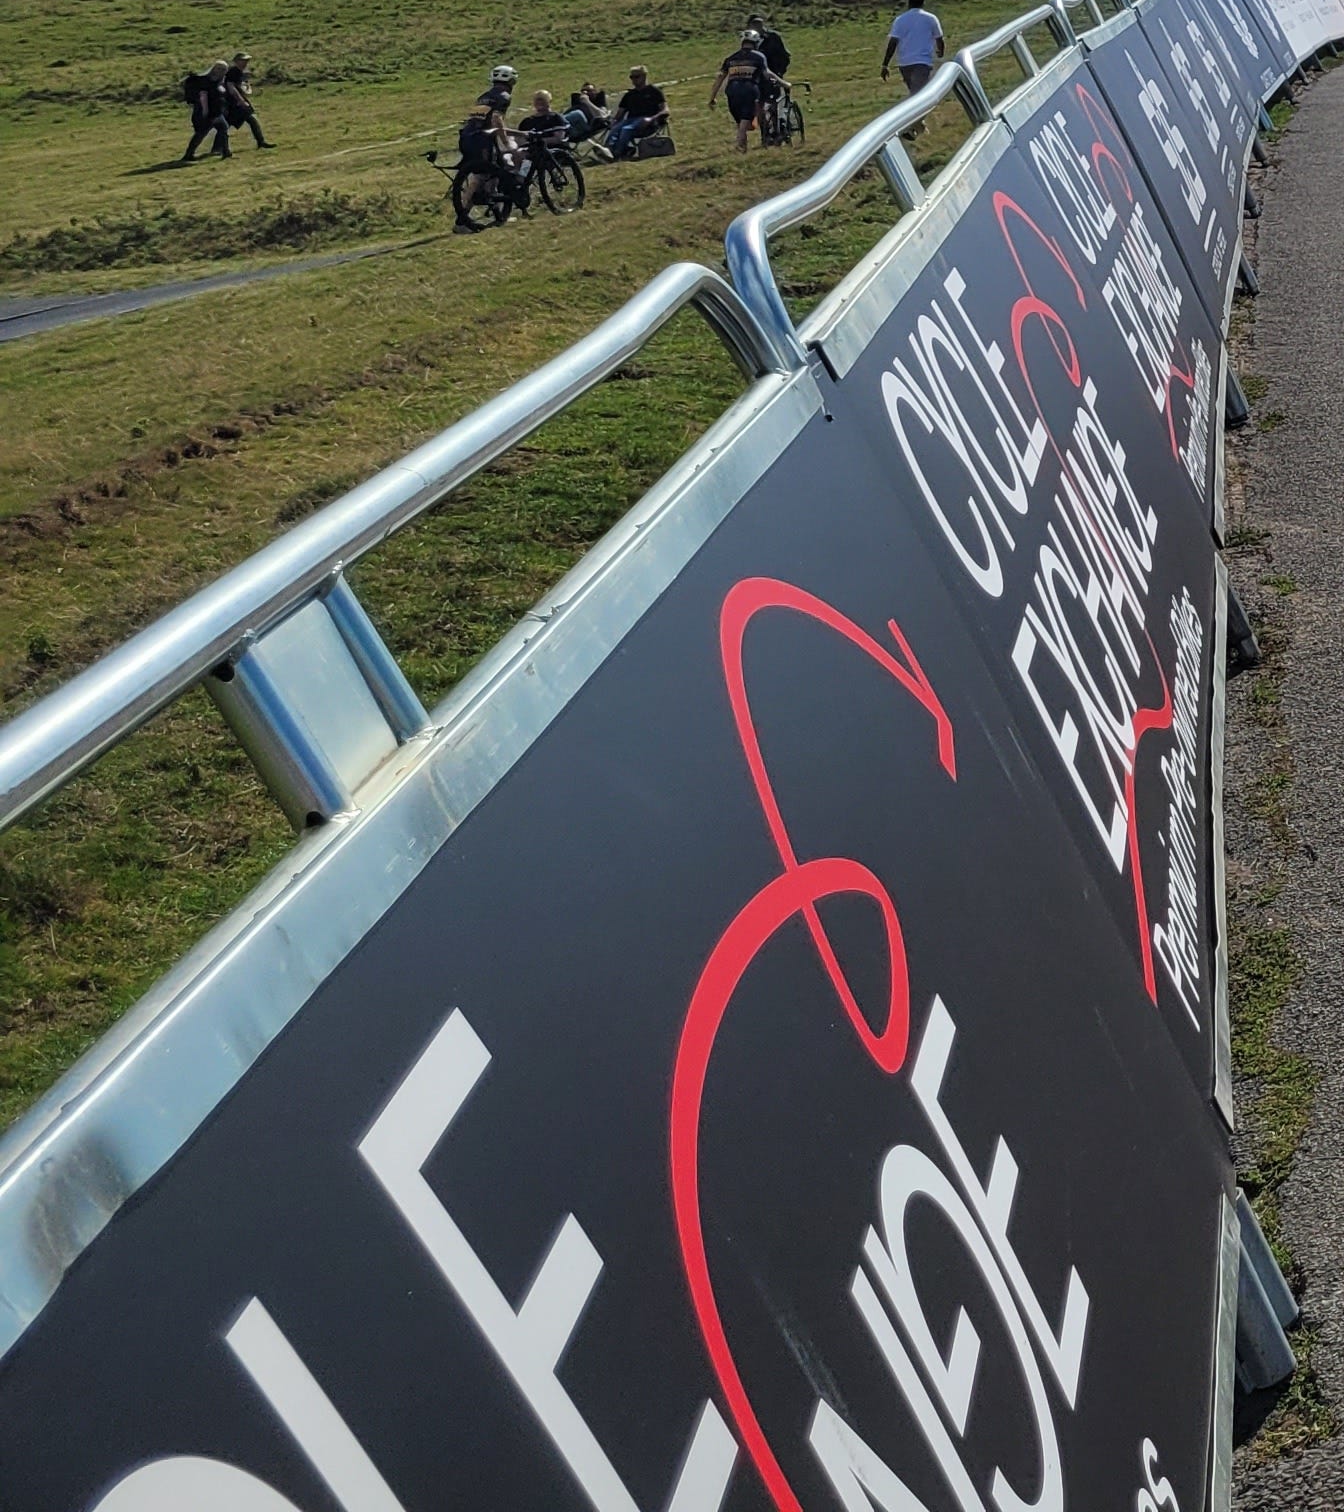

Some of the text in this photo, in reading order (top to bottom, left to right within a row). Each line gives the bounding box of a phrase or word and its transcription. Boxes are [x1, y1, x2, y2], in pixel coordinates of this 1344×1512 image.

[1029, 110, 1118, 265] CYCLE
[881, 266, 1048, 598] CYCLE
[1011, 377, 1158, 875] EXCHANGE
